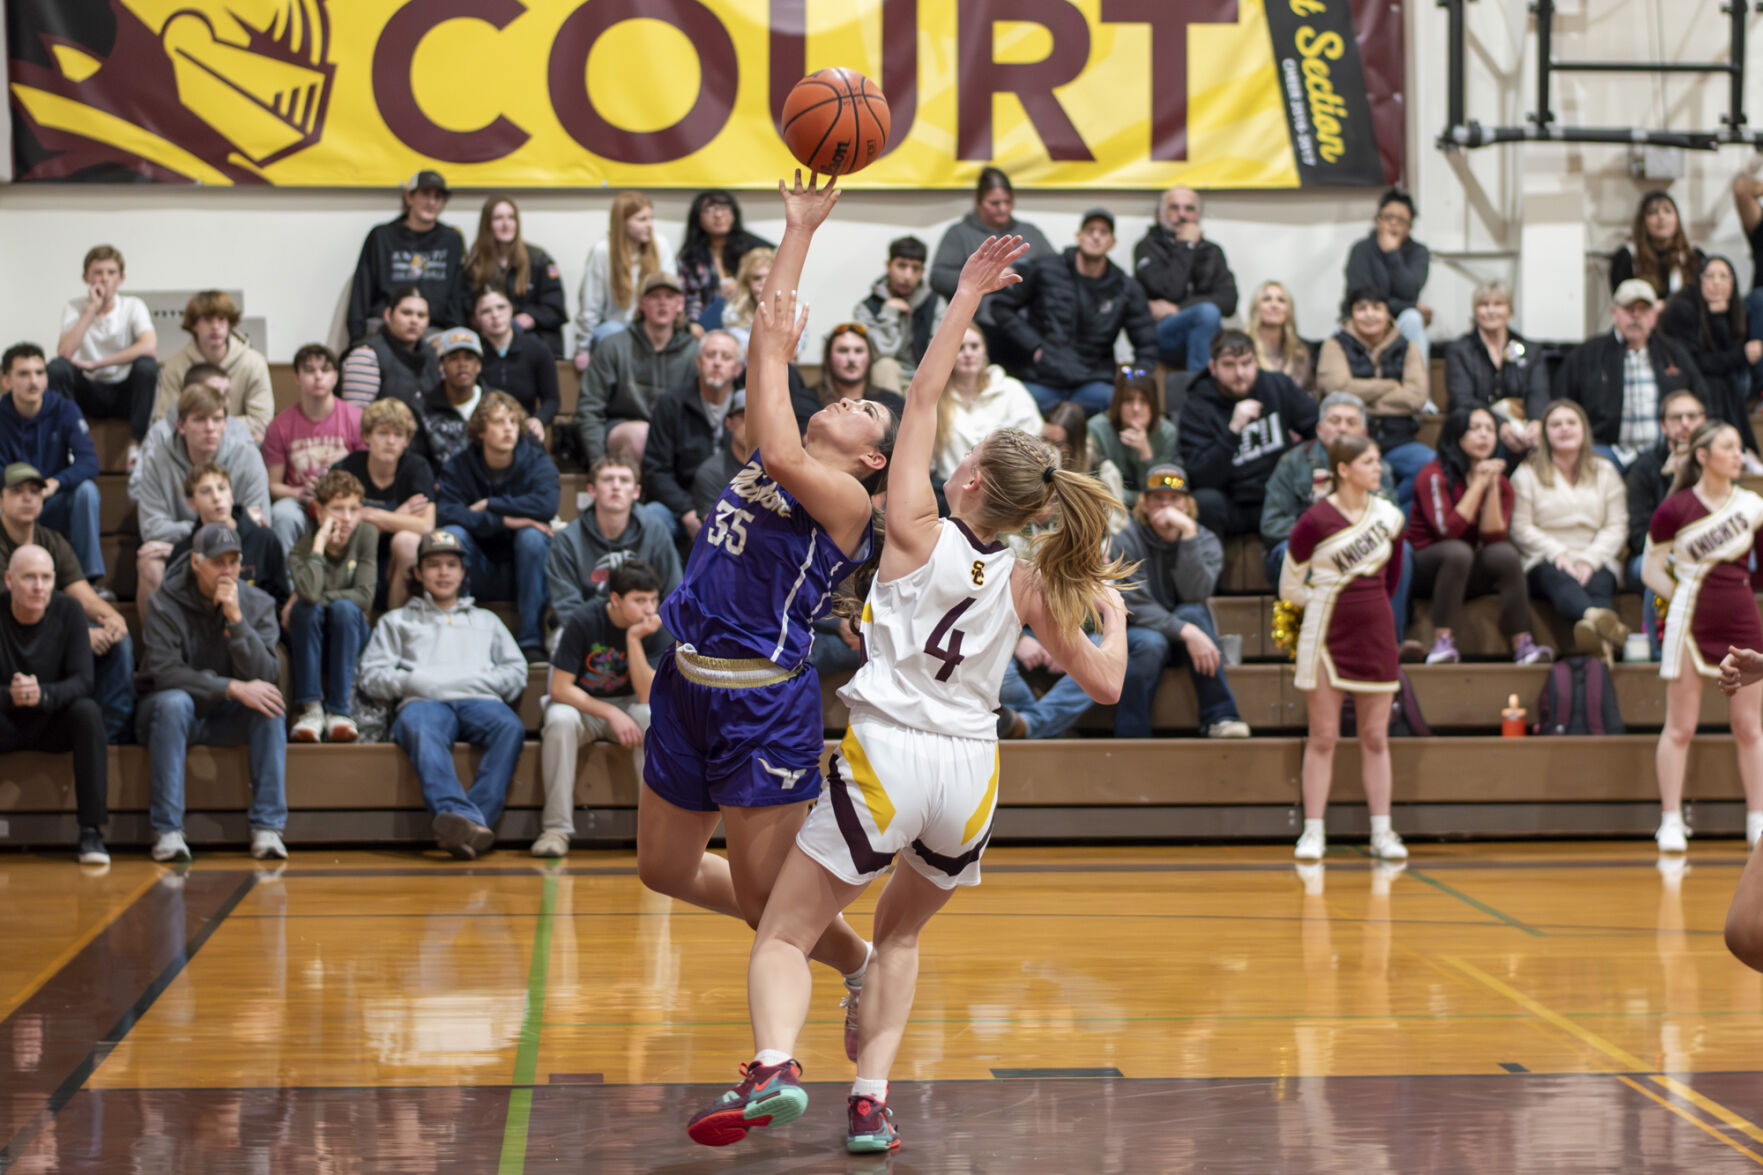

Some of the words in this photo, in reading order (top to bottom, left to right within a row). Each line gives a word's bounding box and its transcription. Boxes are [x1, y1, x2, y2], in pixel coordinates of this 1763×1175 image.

[372, 0, 1239, 164] COURT
[1295, 25, 1349, 164] Section
[707, 498, 755, 556] 35
[1331, 520, 1389, 574] KNIGHTS
[1686, 510, 1748, 564] KNIGHTS
[923, 596, 977, 683] 4
